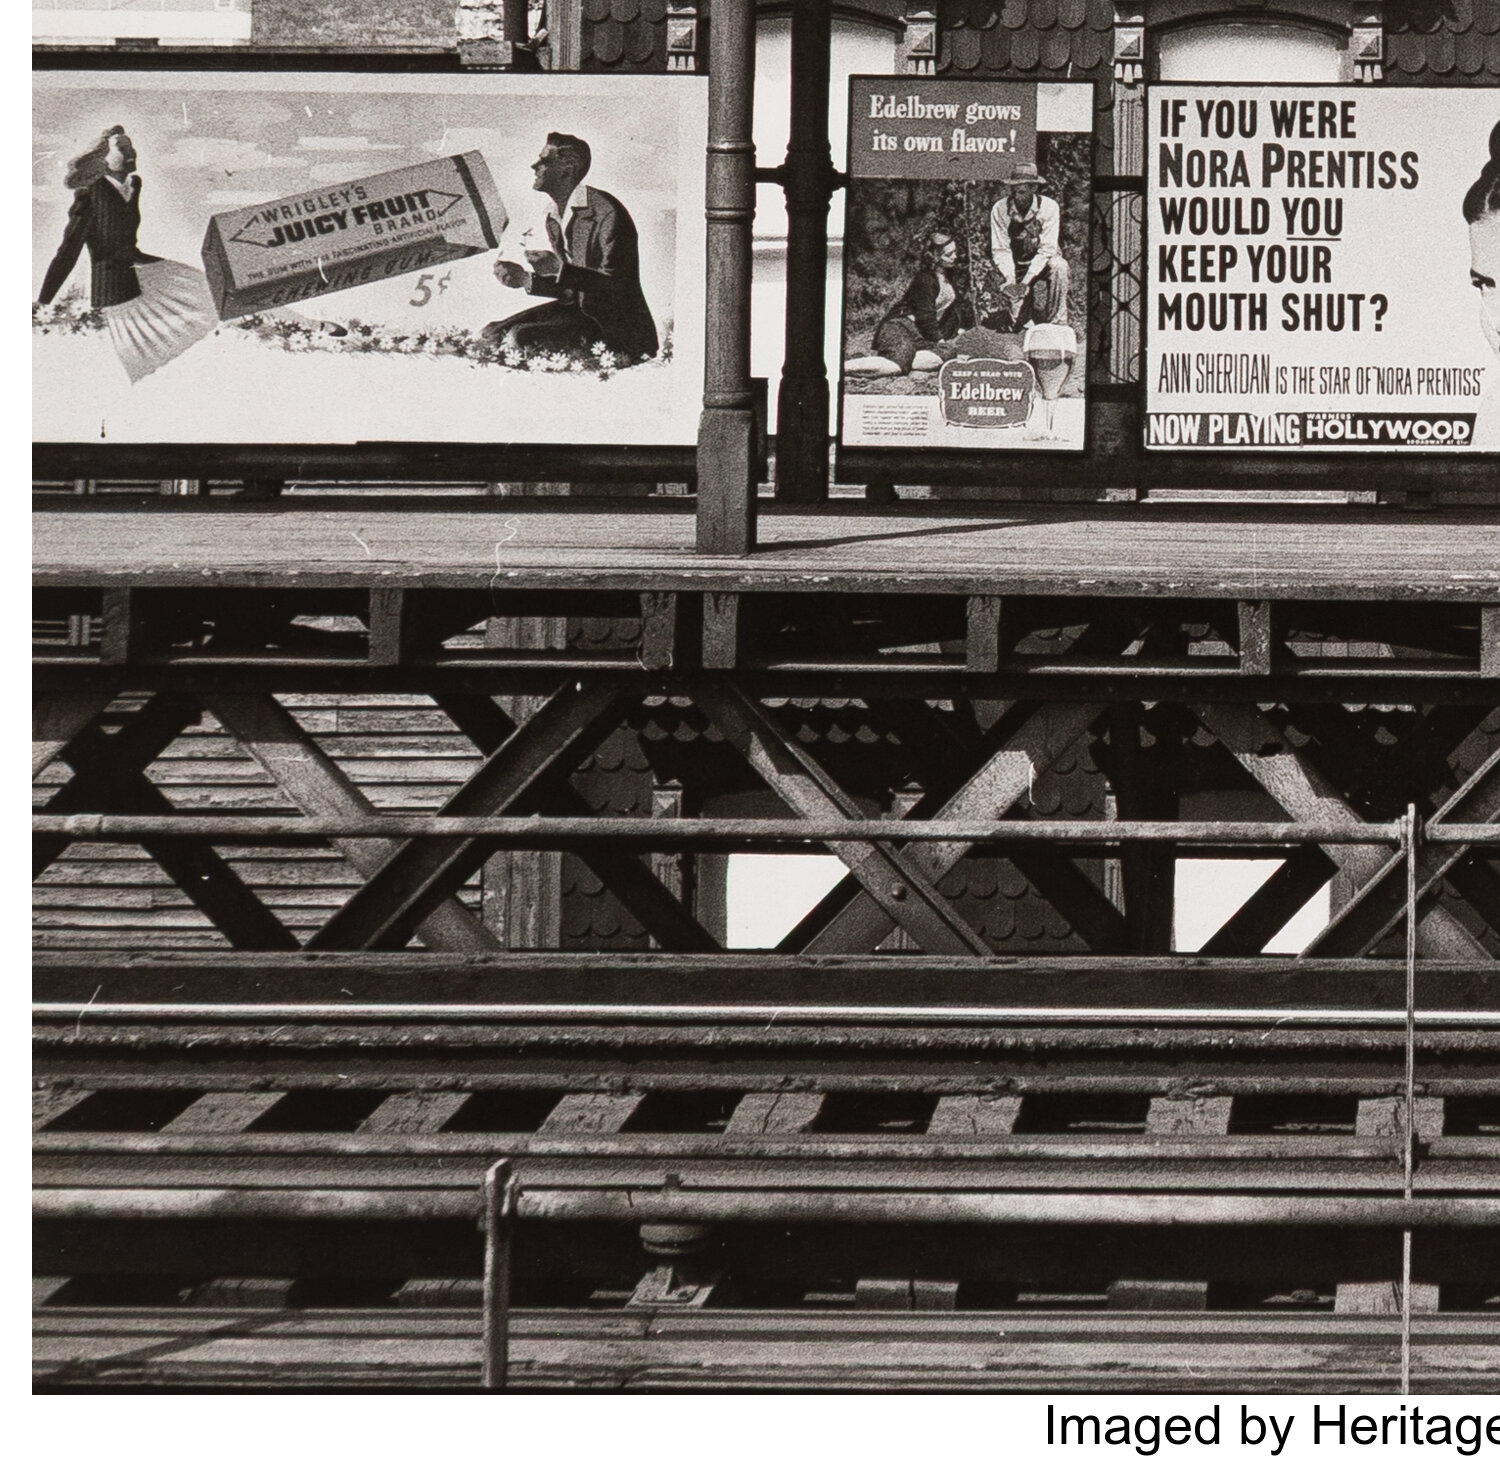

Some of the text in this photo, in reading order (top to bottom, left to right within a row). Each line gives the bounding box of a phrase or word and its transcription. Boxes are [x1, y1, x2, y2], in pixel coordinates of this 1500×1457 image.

[870, 94, 1021, 124] Edelbrew grows
[1160, 99, 1356, 139] IF YOU WERE
[872, 128, 1016, 153] its own flavor!
[1159, 143, 1418, 189] NORA PRENTISS
[260, 185, 367, 224] WRIGLEY'S
[267, 190, 430, 247] JUICY FRUIT
[374, 210, 436, 235] BRAND
[1159, 198, 1342, 235] WOULD YOU
[1159, 245, 1332, 283] KEEP YOUR
[1158, 293, 1388, 332] MOUTH SHUT?
[949, 382, 1024, 401] Edelbrew
[1158, 353, 1192, 394] ANN
[1196, 353, 1270, 394] SHERIDAN
[1275, 368, 1287, 394] IS
[1291, 368, 1315, 394] THE
[1319, 368, 1350, 395] STAR
[1356, 368, 1371, 395] OF
[968, 406, 1007, 416] BEER
[1149, 413, 1301, 444] NOW PLAYING
[1306, 420, 1470, 439] HOLLYWOOD
